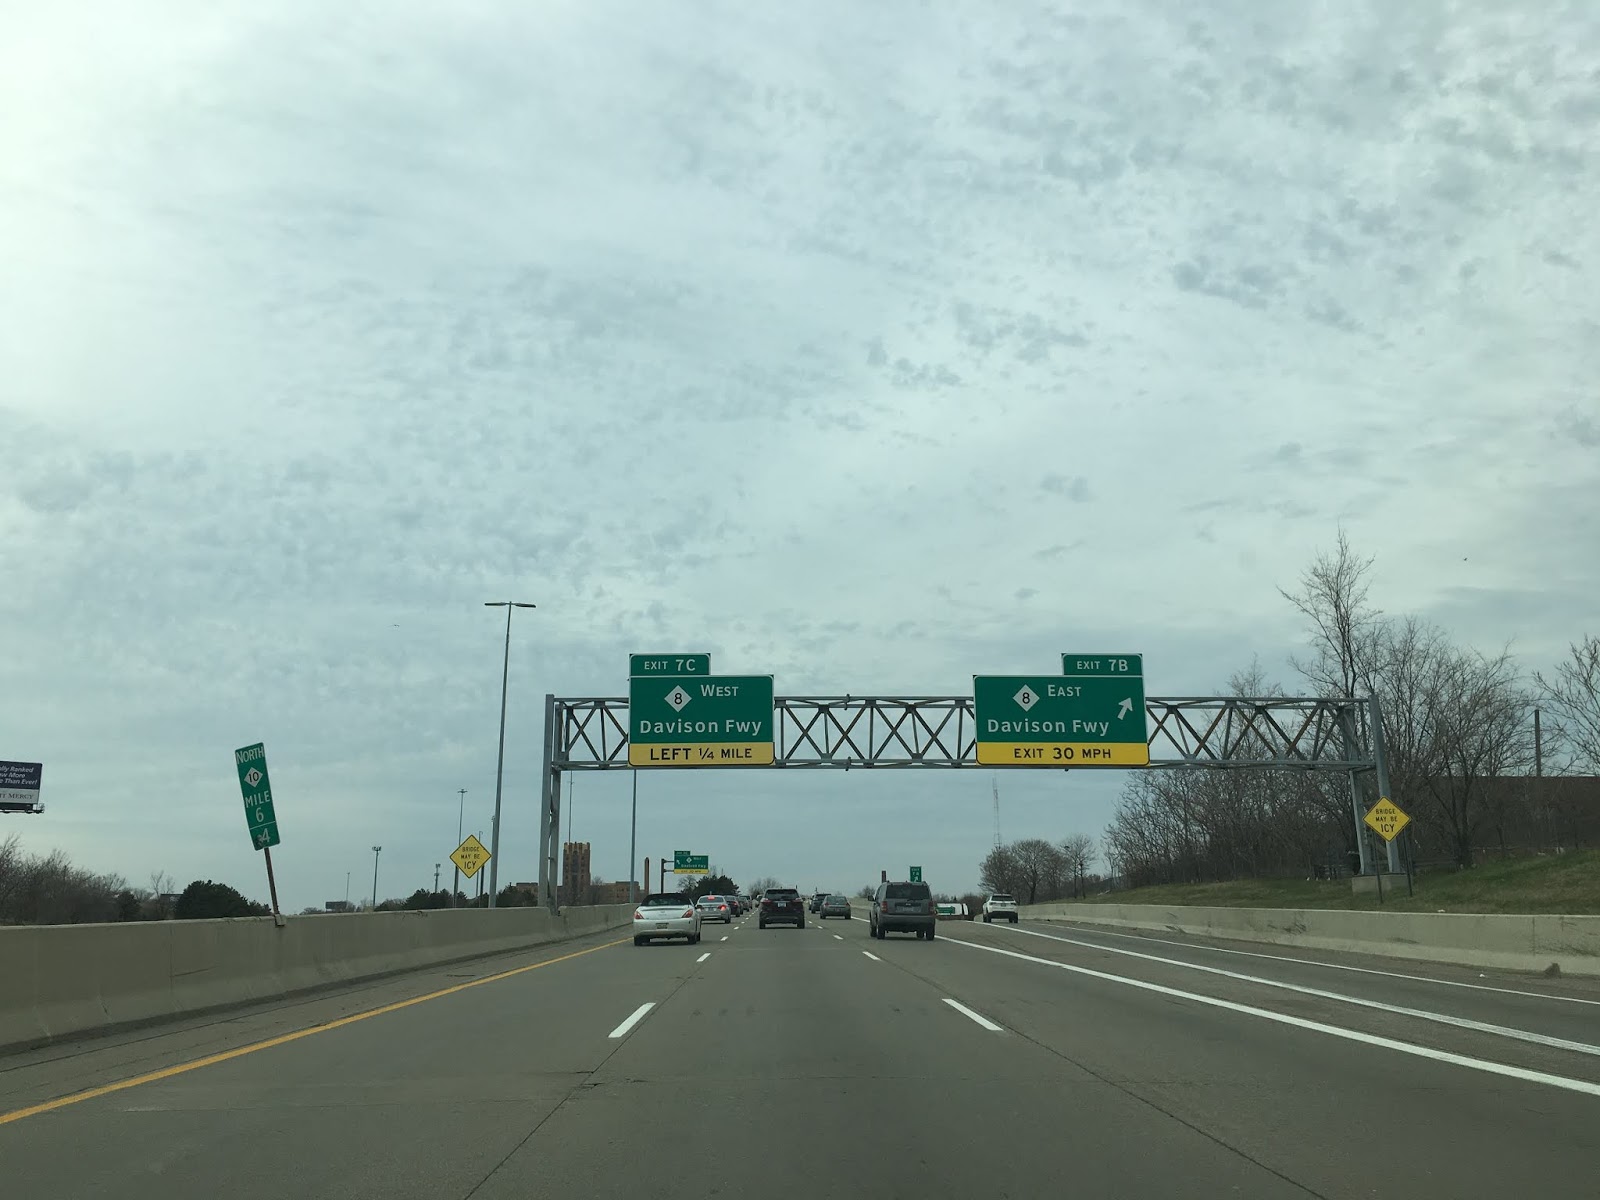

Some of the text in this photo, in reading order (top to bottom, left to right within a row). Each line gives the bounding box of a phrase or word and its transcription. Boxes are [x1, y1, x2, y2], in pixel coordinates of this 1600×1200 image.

[644, 659, 696, 671] EXIT 7C
[1076, 659, 1128, 672] EXIT 7B
[674, 684, 739, 705] 8 WEST
[1022, 684, 1081, 704] 8 EAST
[640, 718, 762, 736] Davison Fwy
[987, 718, 1109, 736] Davison Fwy
[235, 746, 265, 765] NORTH
[650, 748, 692, 761] LEFT
[721, 748, 752, 759] MILE
[1014, 747, 1111, 760] EXIT 30 MPH
[248, 771, 260, 783] 10
[244, 790, 271, 808] MILE
[255, 807, 264, 822] 6
[1380, 823, 1395, 833] ICY
[464, 860, 477, 870] ICY
